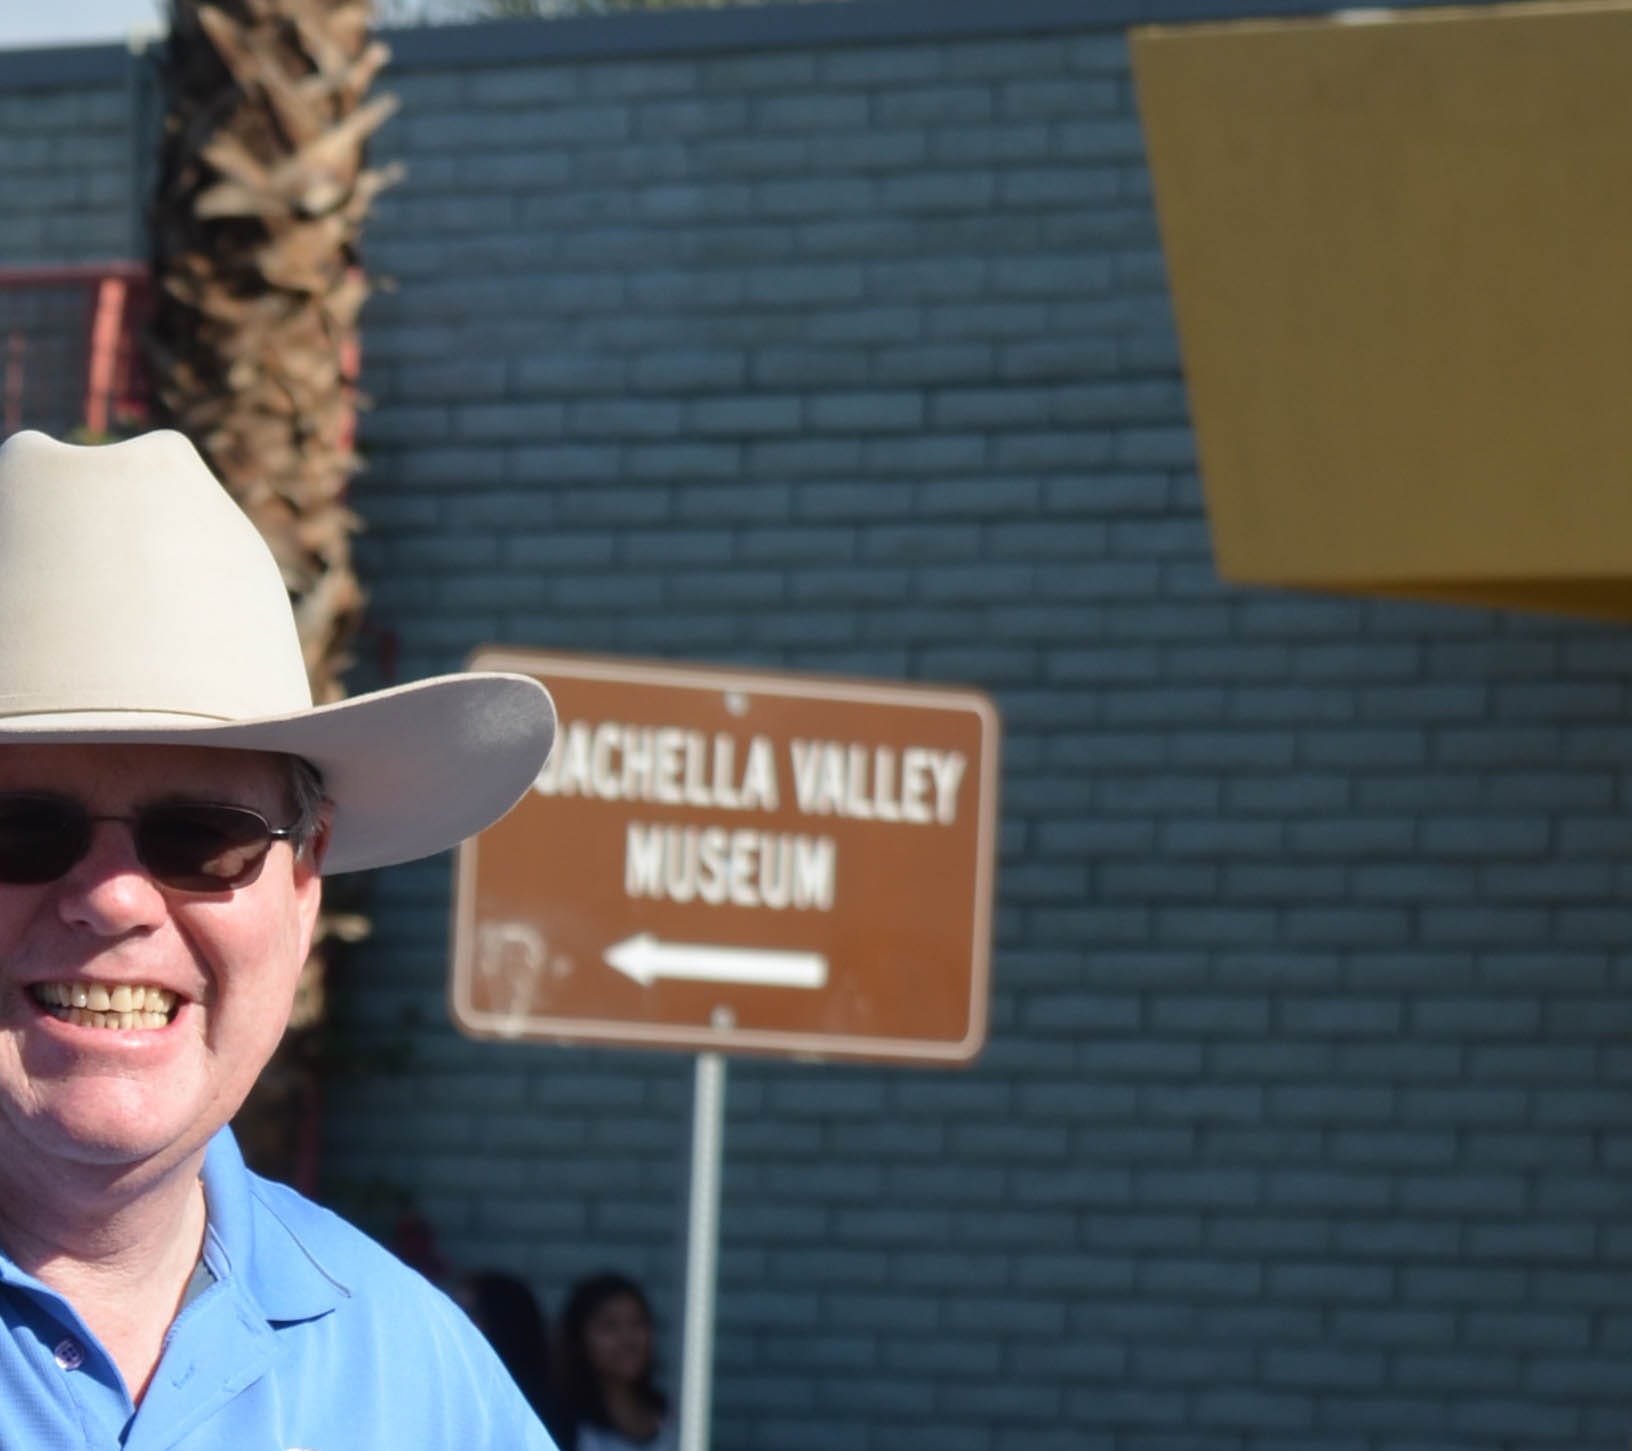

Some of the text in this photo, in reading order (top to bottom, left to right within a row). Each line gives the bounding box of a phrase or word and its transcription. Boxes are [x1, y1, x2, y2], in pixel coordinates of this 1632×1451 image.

[532, 720, 967, 824] ACHELLA VALLEY
[624, 821, 837, 911] MUSEUM
